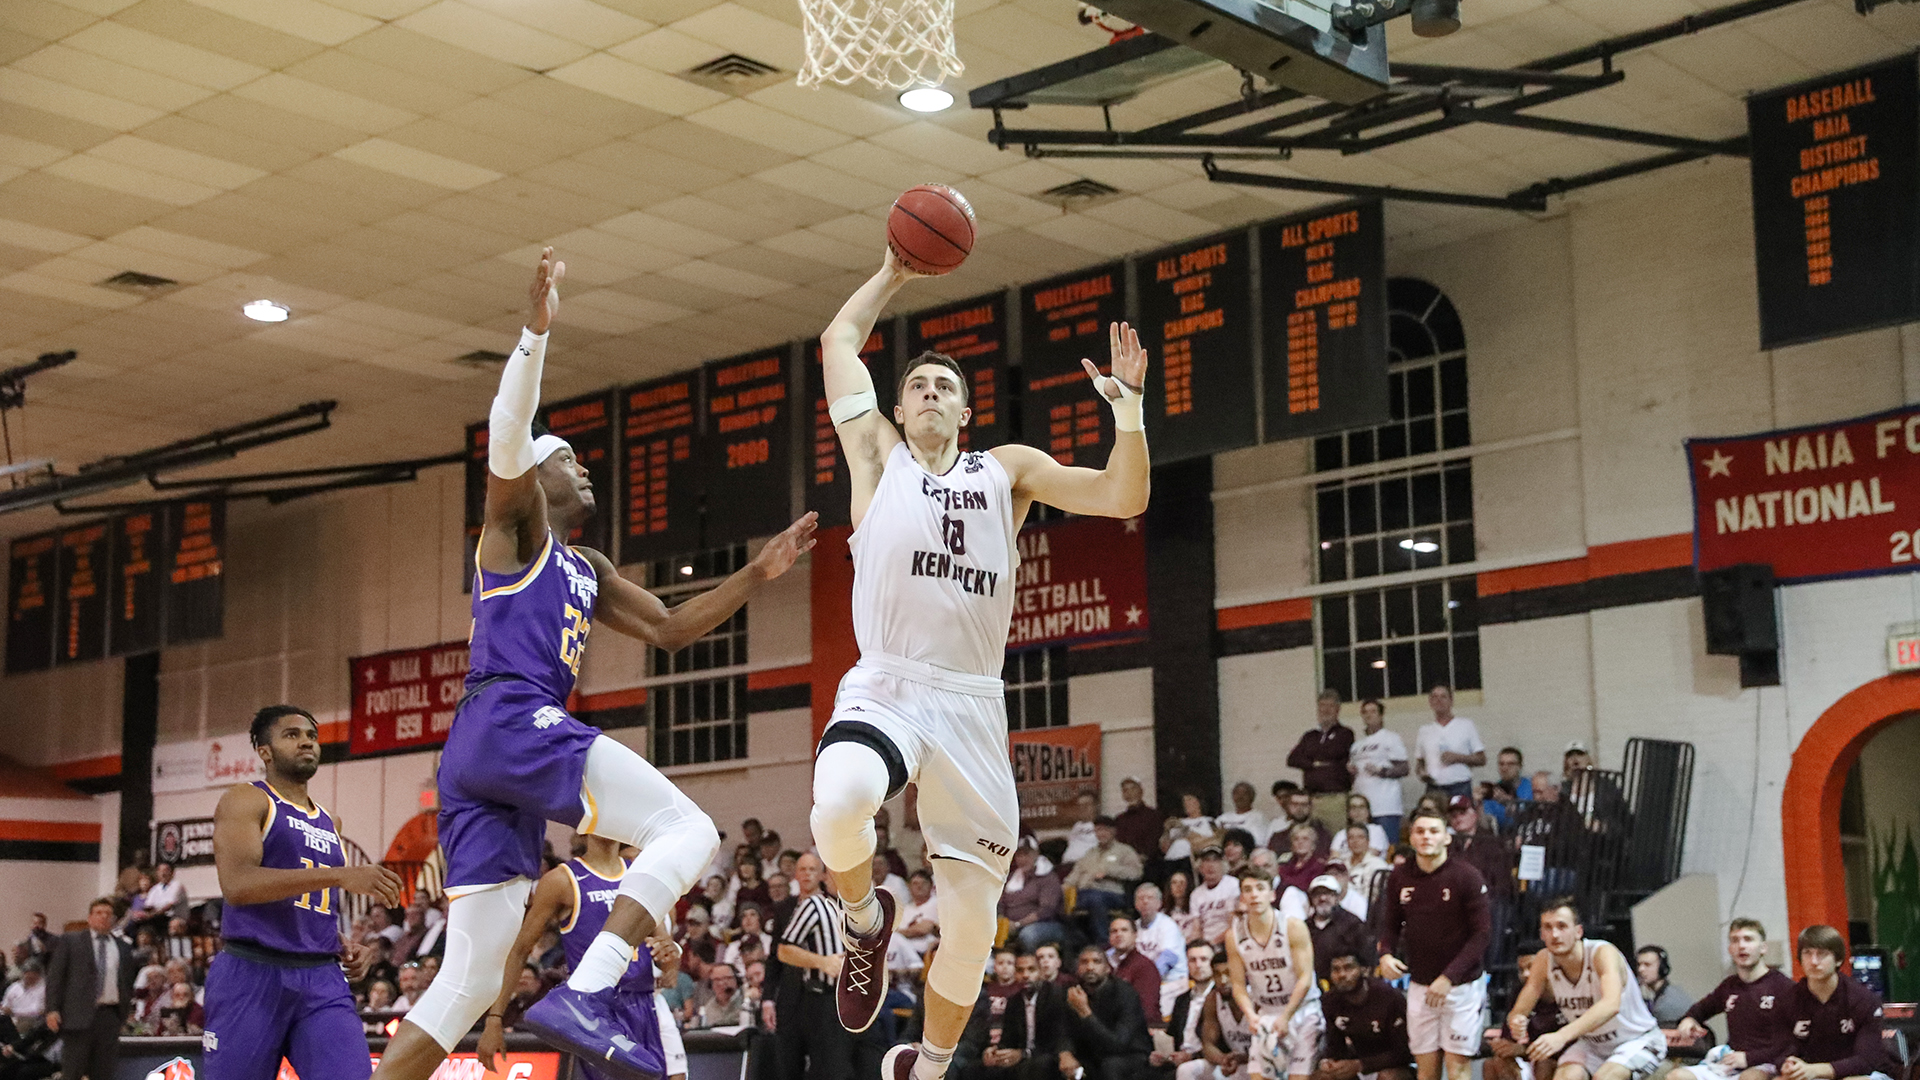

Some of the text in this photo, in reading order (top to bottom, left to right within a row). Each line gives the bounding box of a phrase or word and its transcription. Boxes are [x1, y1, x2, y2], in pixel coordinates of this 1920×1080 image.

[1786, 78, 1876, 123] BASEBALL
[1813, 114, 1850, 141] NAIA
[1800, 134, 1867, 170] DISTRICT
[1791, 157, 1880, 198] CHAMPIONS
[1282, 210, 1359, 249] ALL SPORTS
[1156, 243, 1227, 282] ALL SPORTS
[1764, 430, 1855, 476] NAIA
[1715, 476, 1896, 534] NATIONAL
[941, 513, 966, 555] 10
[1017, 532, 1050, 559] AIA
[911, 550, 998, 597] KENUCKY
[1014, 578, 1107, 614] KETBALL
[365, 684, 431, 716] FOOTBALL
[1014, 742, 1094, 783] EYBALL
[303, 831, 331, 855] TECH
[586, 889, 619, 903] TENN
[1441, 888, 1451, 901] 3
[1264, 974, 1283, 993] 23
